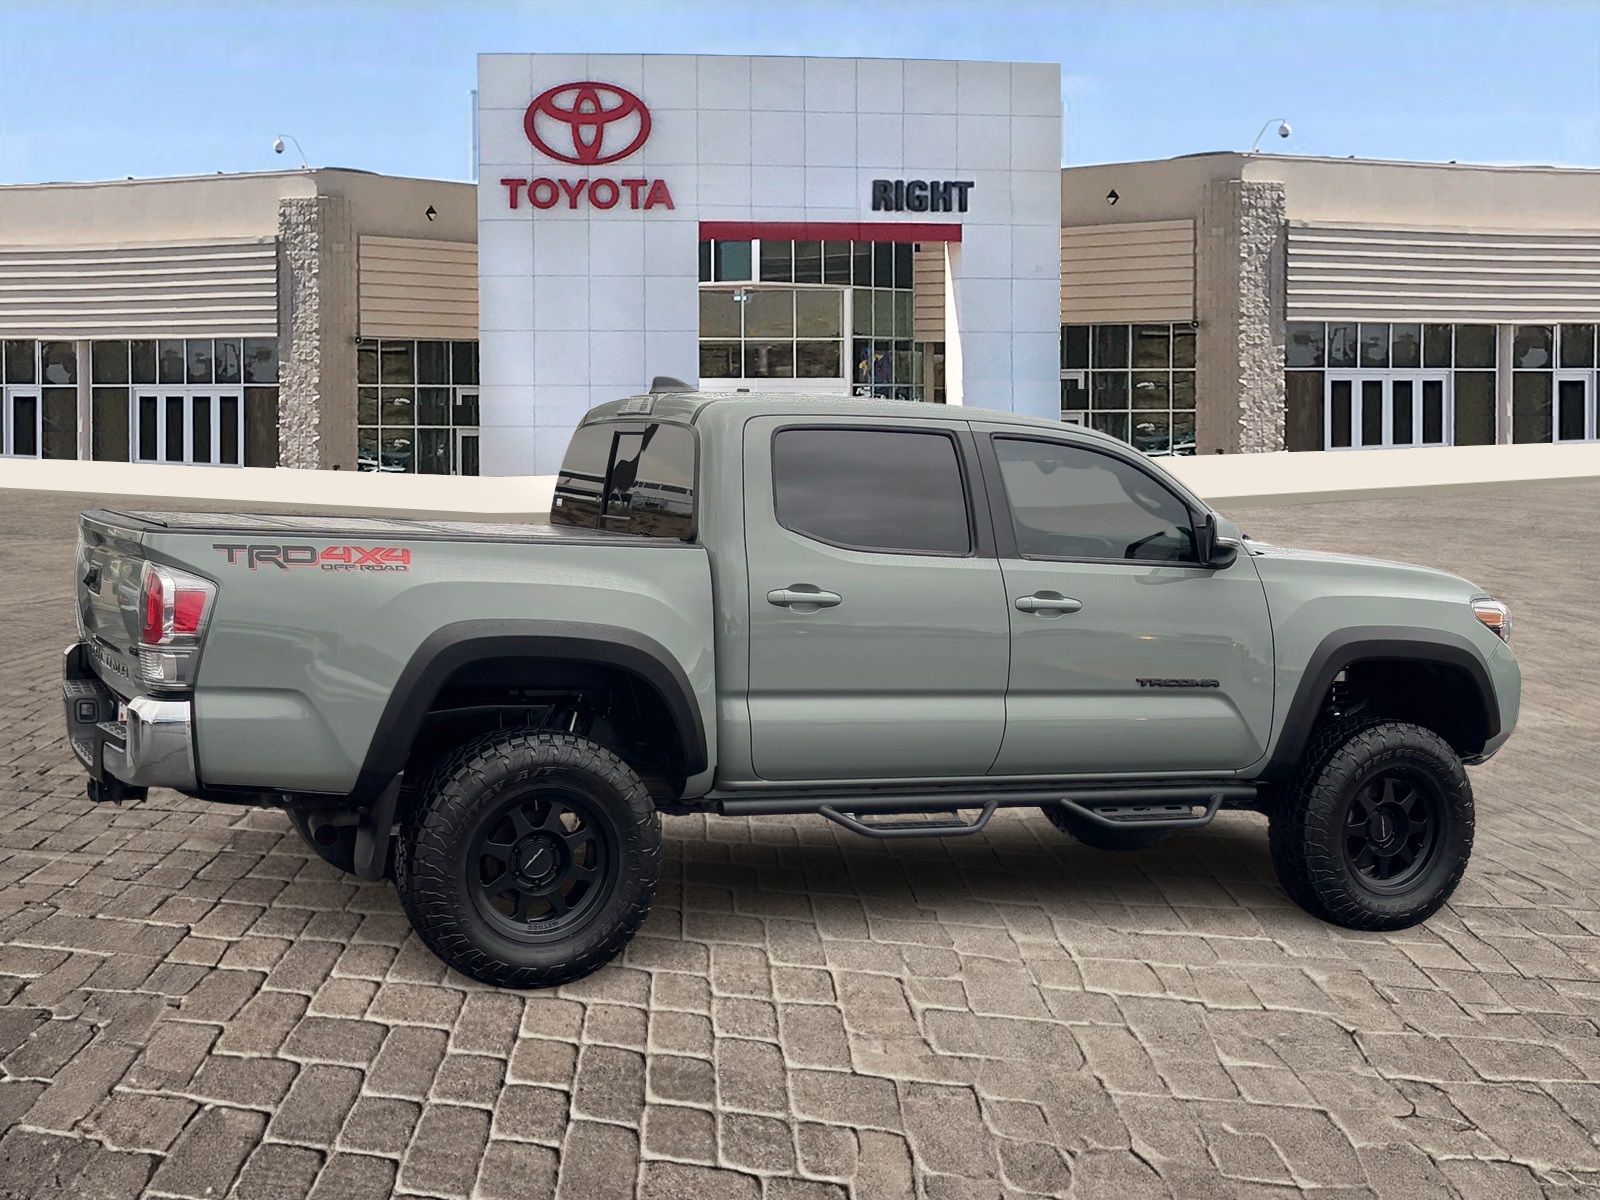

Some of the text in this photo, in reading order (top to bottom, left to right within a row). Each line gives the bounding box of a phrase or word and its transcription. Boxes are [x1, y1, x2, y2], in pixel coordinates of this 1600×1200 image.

[500, 177, 675, 210] TOYOTA
[872, 179, 975, 213] RIGHT
[213, 543, 320, 570] TRD
[321, 563, 409, 573] OFF ROAD
[1135, 678, 1220, 688] TACOMA
